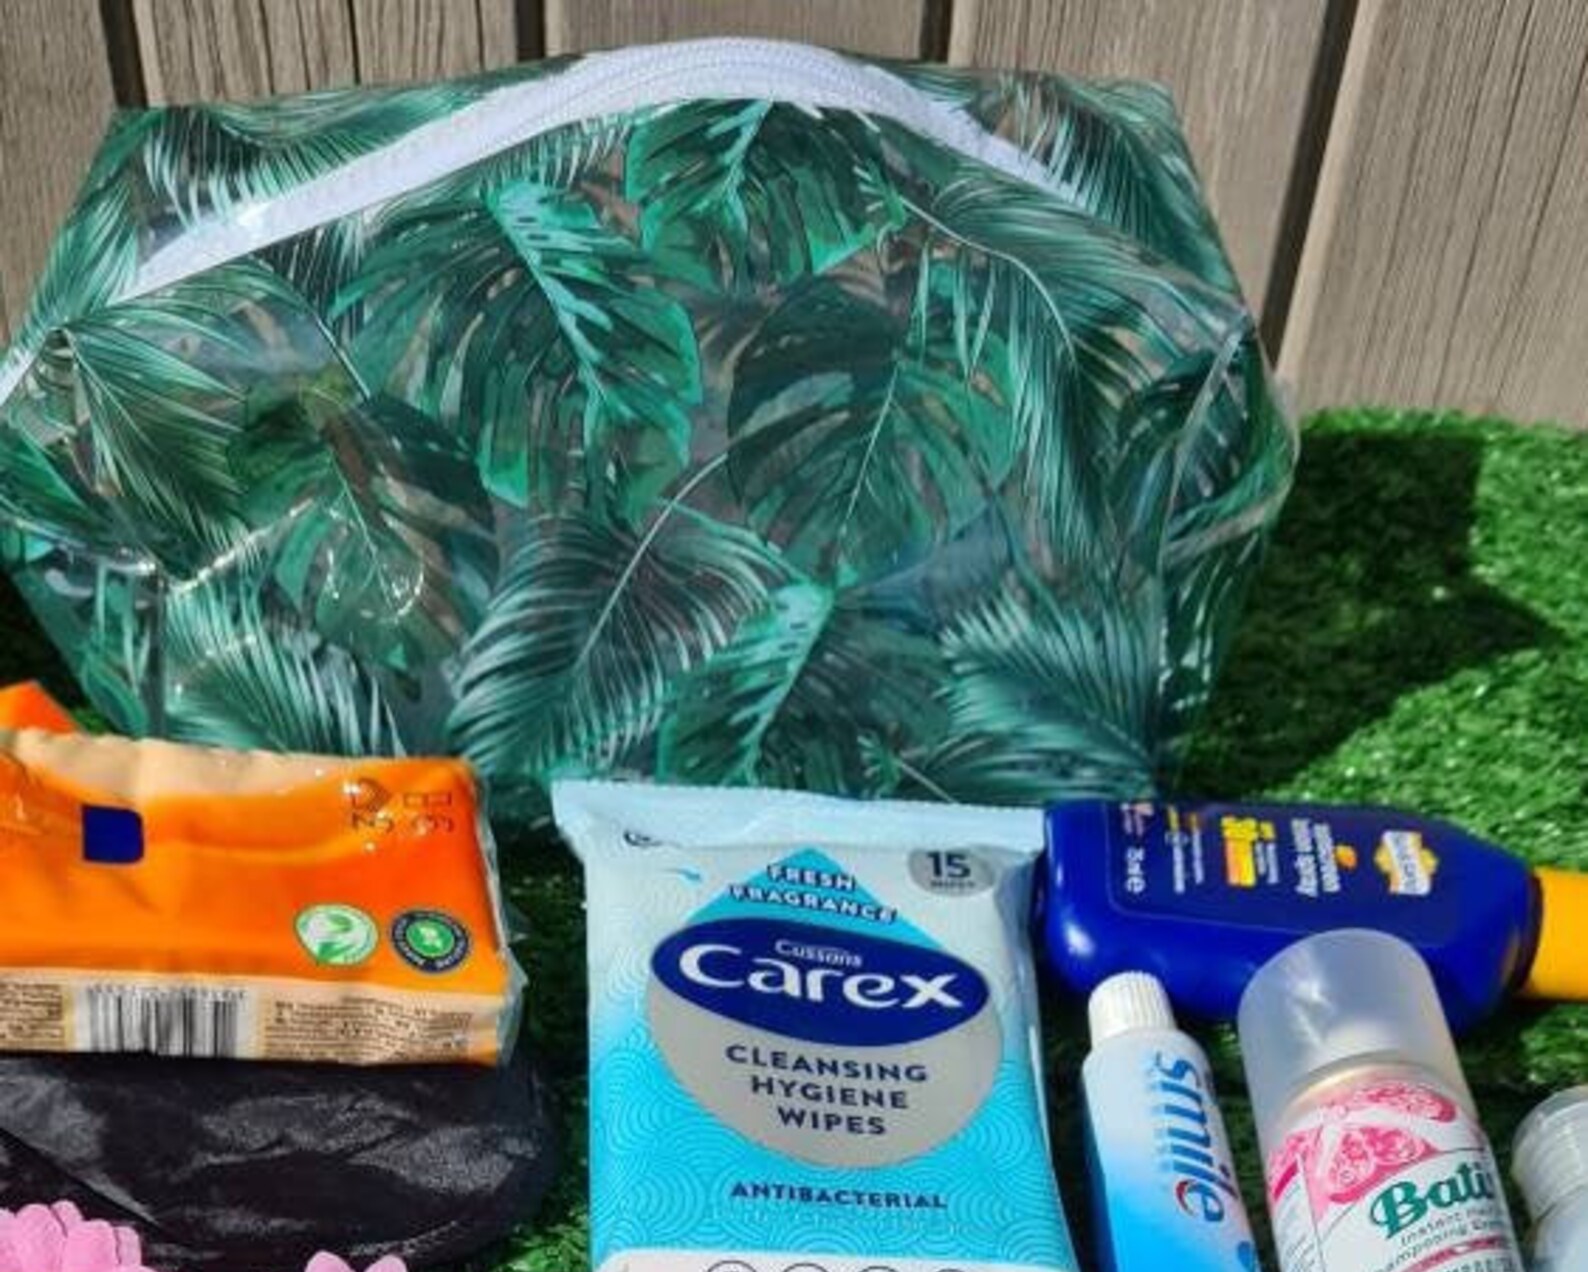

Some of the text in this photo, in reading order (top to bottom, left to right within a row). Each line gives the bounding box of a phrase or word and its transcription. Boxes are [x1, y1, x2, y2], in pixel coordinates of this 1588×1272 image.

[766, 863, 857, 892] FRESH
[926, 850, 972, 879] 15
[729, 882, 899, 923] FRAGRANCE
[774, 937, 863, 969] Cussons
[678, 942, 963, 1010] Carex
[725, 1043, 928, 1083] CLEANSING
[750, 1074, 909, 1110] HYGIENE
[776, 1105, 887, 1136] WIPES
[1154, 1051, 1239, 1222] smile
[730, 1180, 948, 1209] ANTIBACTERIAL
